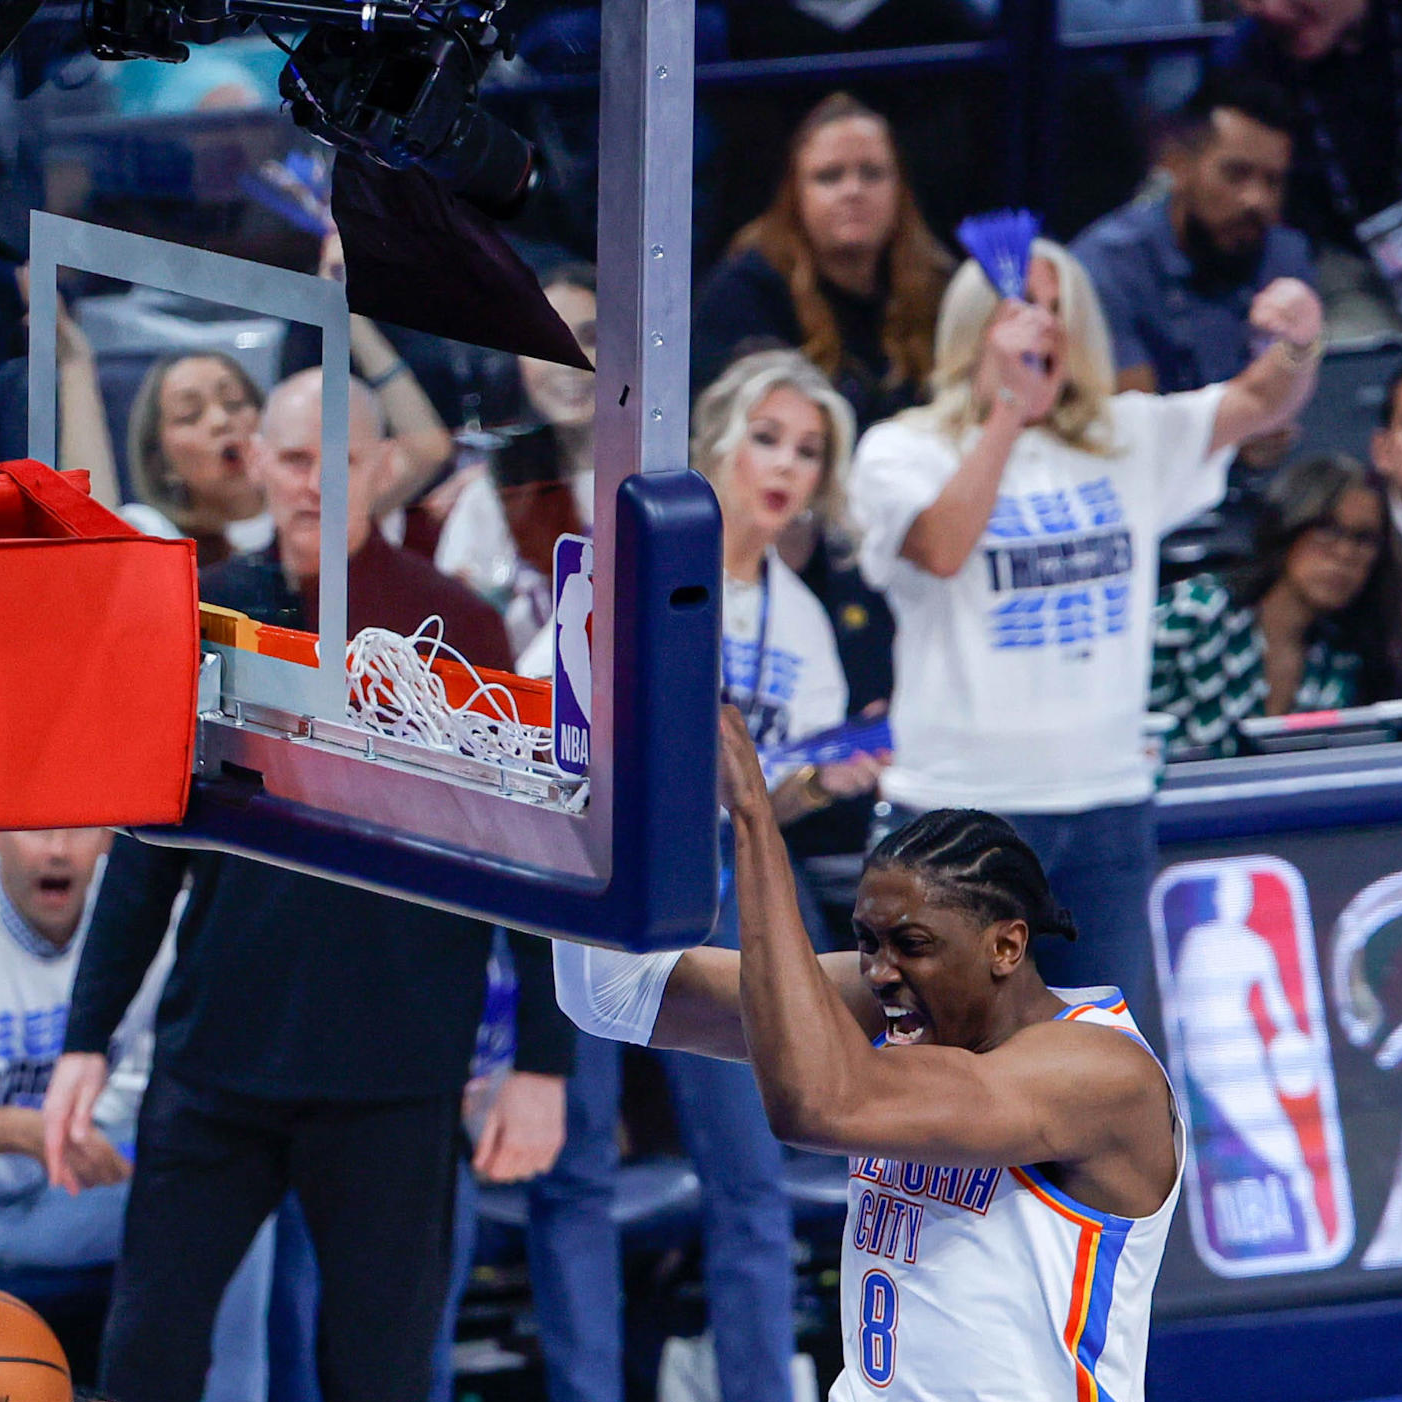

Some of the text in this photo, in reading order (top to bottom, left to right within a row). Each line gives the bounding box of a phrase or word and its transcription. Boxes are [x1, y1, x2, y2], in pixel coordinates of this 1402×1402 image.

[561, 723, 589, 766] NBA
[854, 1189, 924, 1265] CITY
[859, 1268, 899, 1389] 8
